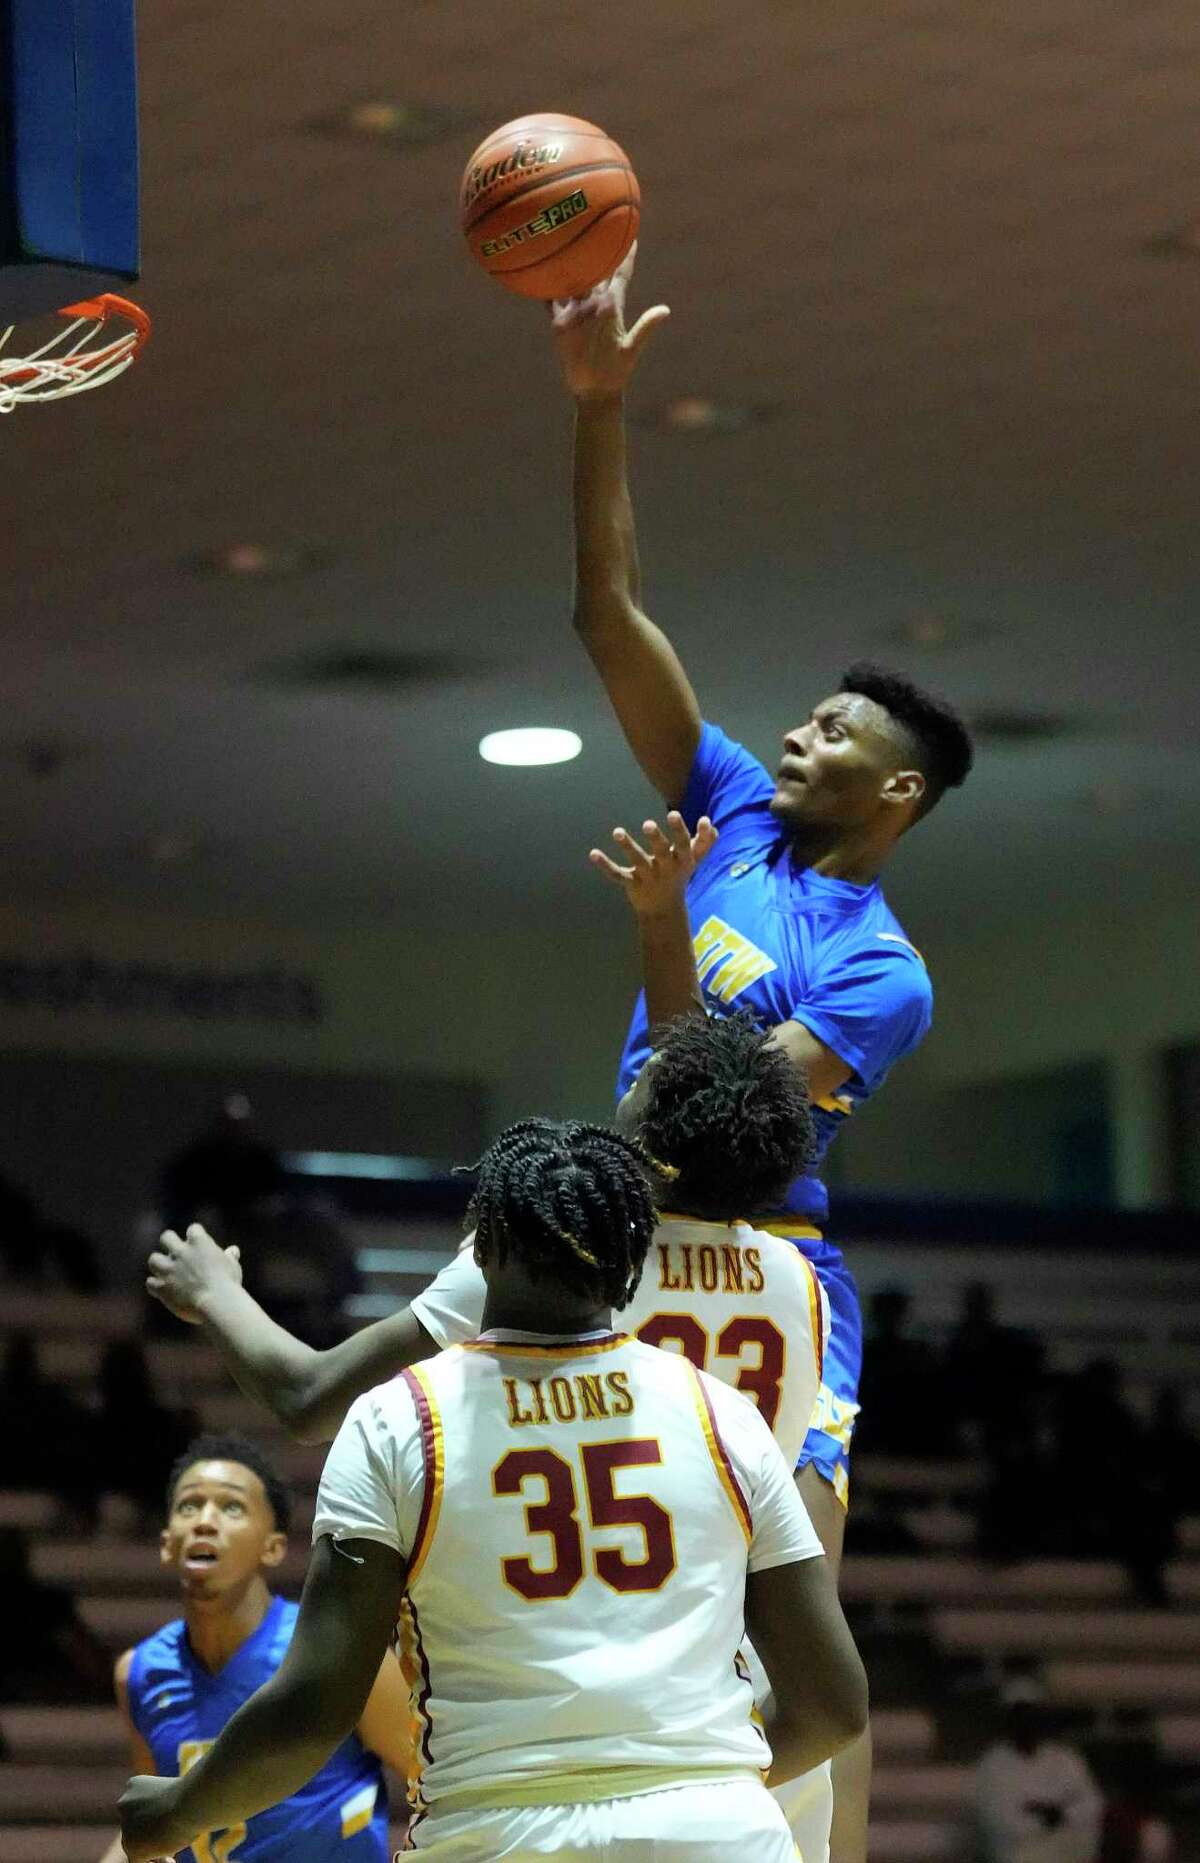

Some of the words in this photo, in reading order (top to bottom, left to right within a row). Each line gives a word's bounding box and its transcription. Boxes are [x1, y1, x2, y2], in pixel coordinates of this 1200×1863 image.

[659, 1243, 764, 1294] LIONS
[503, 1371, 636, 1427] LIONS
[490, 1437, 679, 1602] 35
